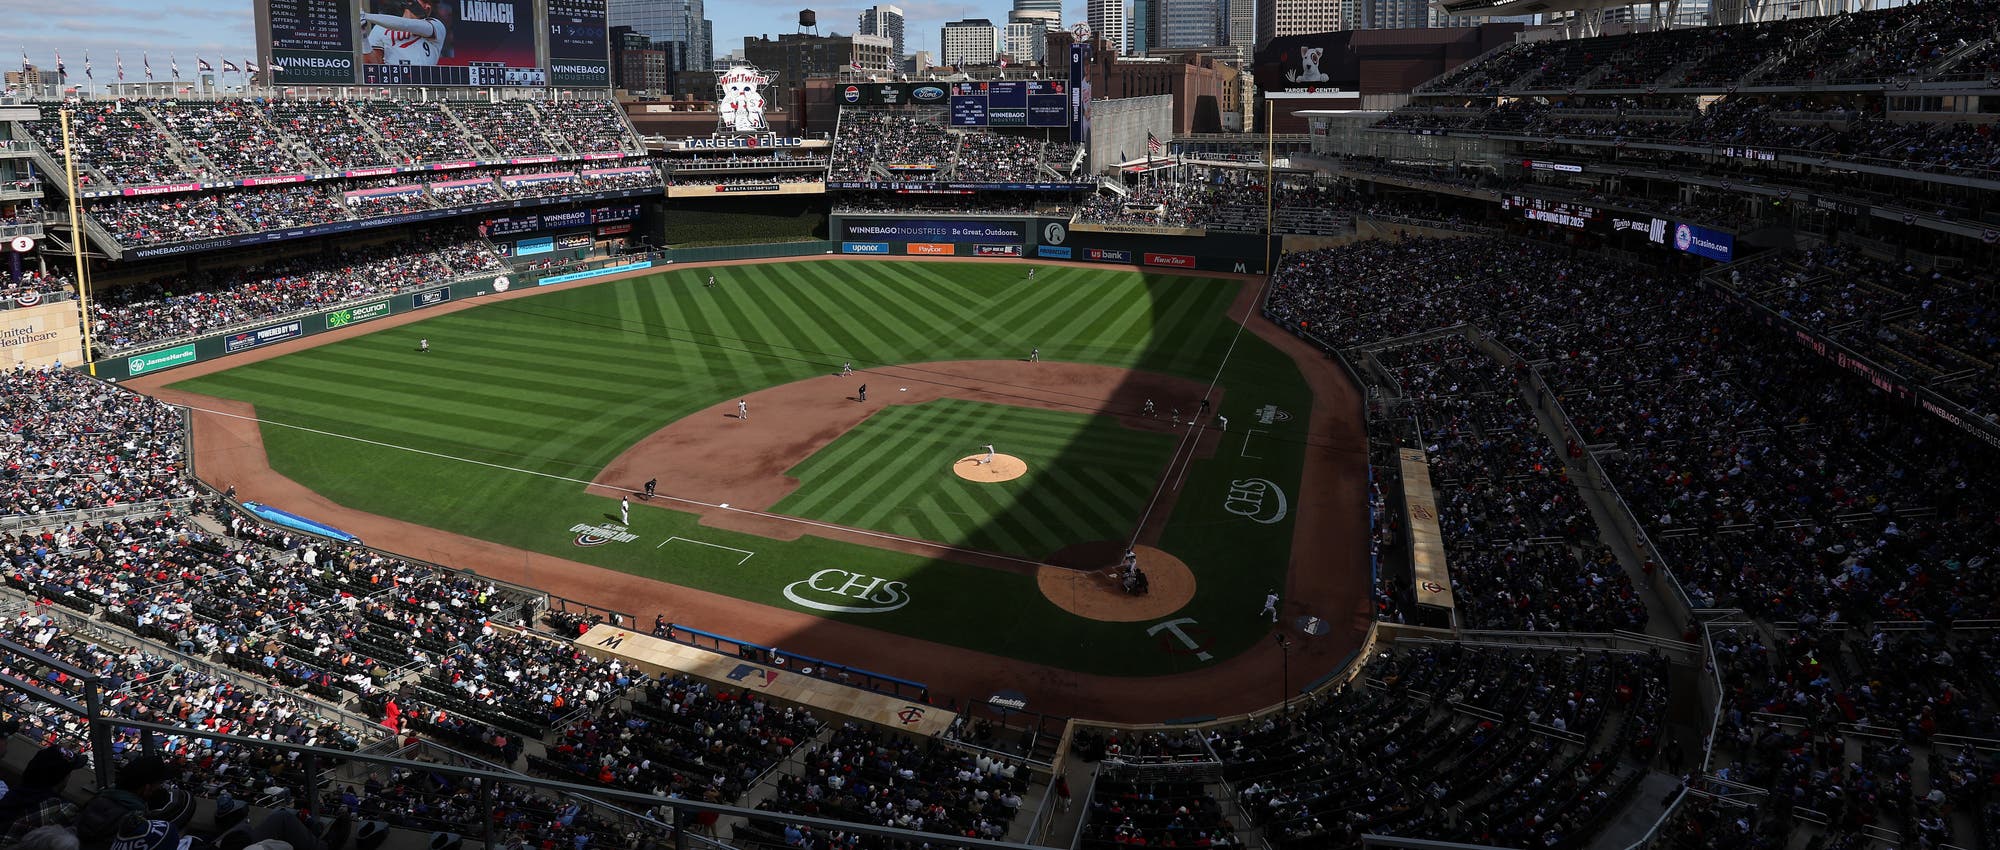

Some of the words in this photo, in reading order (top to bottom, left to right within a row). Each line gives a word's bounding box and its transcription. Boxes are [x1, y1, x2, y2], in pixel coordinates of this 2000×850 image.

[460, 0, 514, 23] LARNACH
[509, 24, 514, 32] 9
[423, 42, 430, 57] 9
[276, 57, 351, 68] WINNEBAGO
[1073, 53, 1079, 63] 9
[280, 68, 350, 76] INDUSTRIES
[551, 65, 606, 74] WINNEBAGO
[720, 74, 740, 85] Win!
[740, 74, 769, 85] Twins!
[919, 89, 937, 98] Ford
[685, 138, 745, 148] TARGET
[761, 137, 803, 147] FIELD
[133, 186, 168, 195] Treasure
[360, 218, 392, 227] WINNEBAGO
[543, 212, 585, 222] WINNEBAGO
[1536, 210, 1559, 223] OPENING
[1559, 214, 1570, 225] DAY
[1570, 217, 1584, 228] 2025
[1613, 218, 1631, 231] Twins
[1631, 221, 1643, 232] RISE
[897, 227, 946, 235] INDUSTRIES
[985, 228, 1018, 236] Outdoors.
[1649, 218, 1667, 245] ONE
[137, 246, 186, 257] WINNEBAGO
[186, 240, 232, 251] INDUSTRIES
[852, 244, 879, 252] uponor
[918, 246, 942, 254] Paycor
[1102, 250, 1122, 259] bank
[353, 303, 386, 316] securian
[353, 312, 377, 320] FINANCIAL
[257, 327, 282, 339] POWERED
[288, 323, 299, 331] YOU
[146, 351, 193, 366] JamesHardie
[1922, 400, 1960, 426] WINNEBAGO
[1960, 420, 2000, 448] INDUSTRIES
[569, 523, 619, 538] OPENING
[611, 531, 640, 543] DAY
[808, 568, 908, 604] CHS
